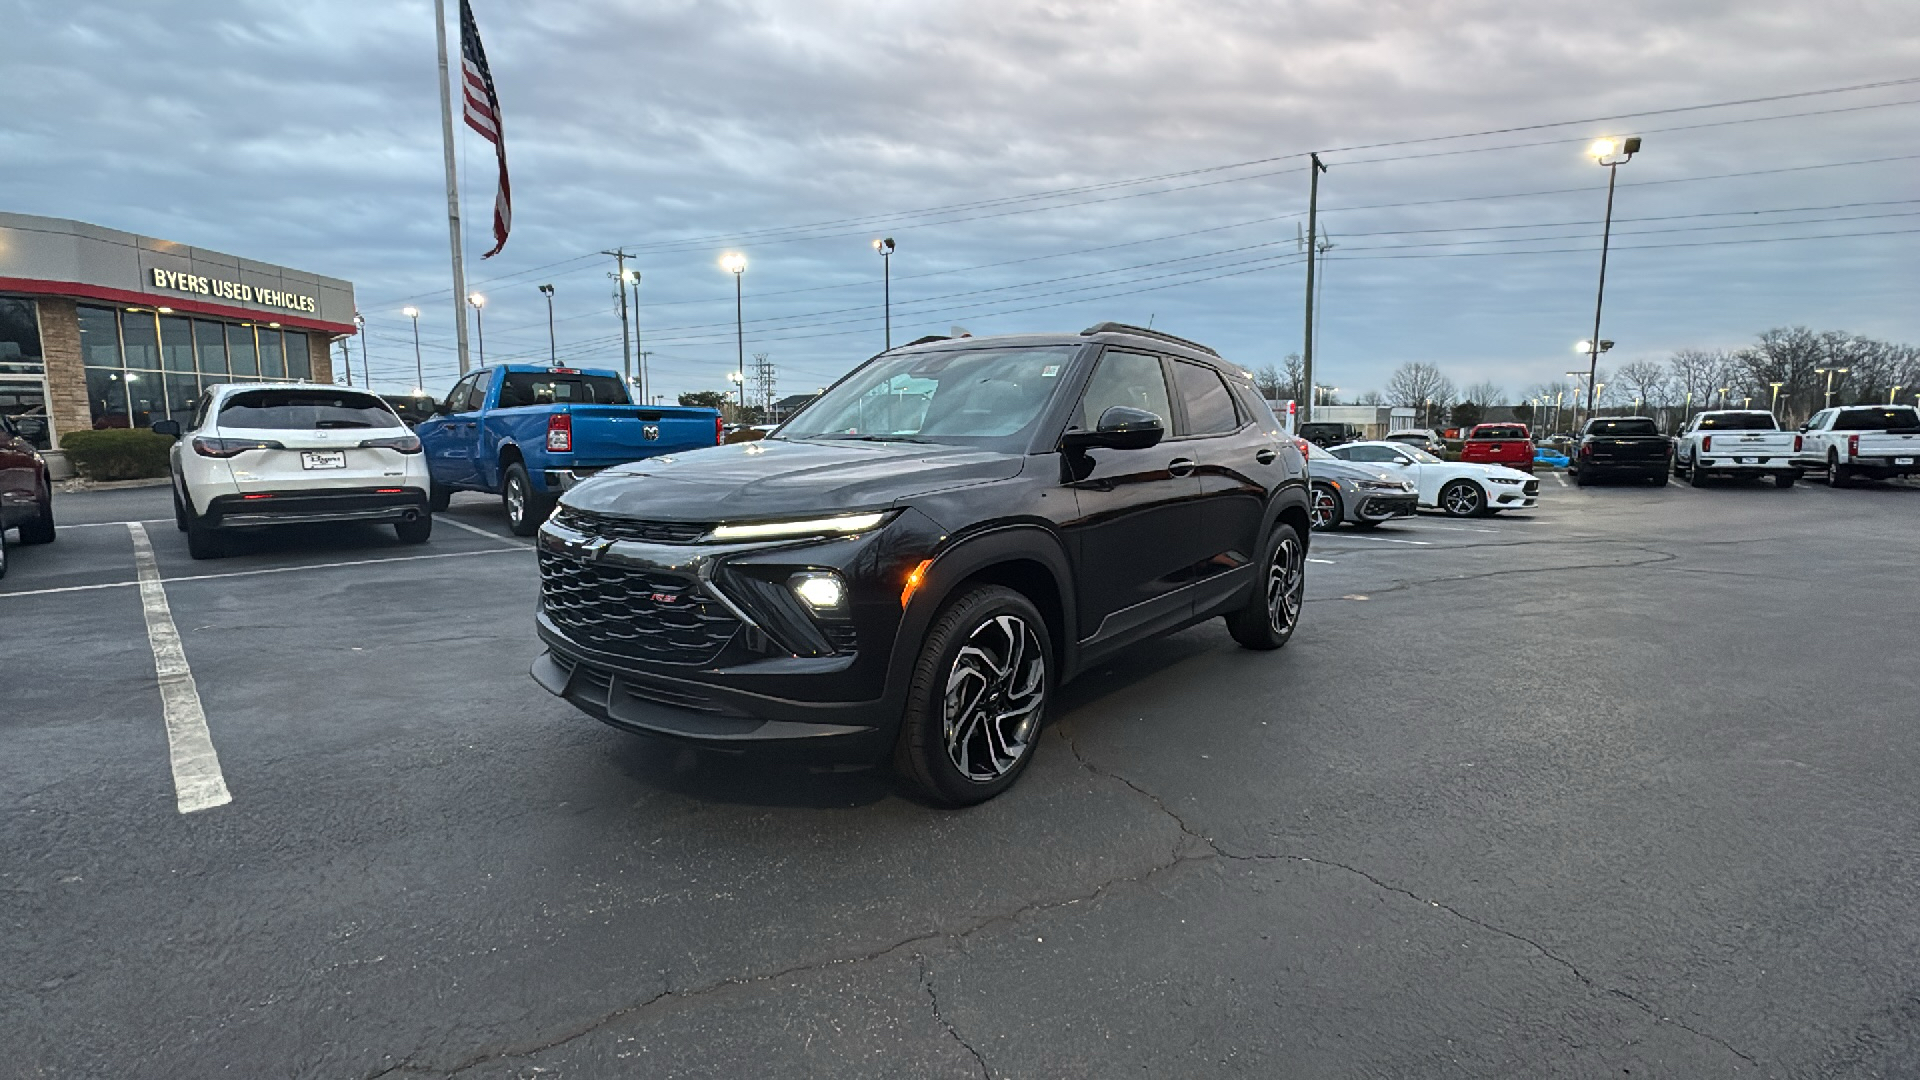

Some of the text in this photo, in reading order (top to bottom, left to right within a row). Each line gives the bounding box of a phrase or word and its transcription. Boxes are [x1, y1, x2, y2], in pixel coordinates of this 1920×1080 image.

[152, 267, 316, 313] BYERS USED VEHICLES
[650, 593, 677, 602] RS
